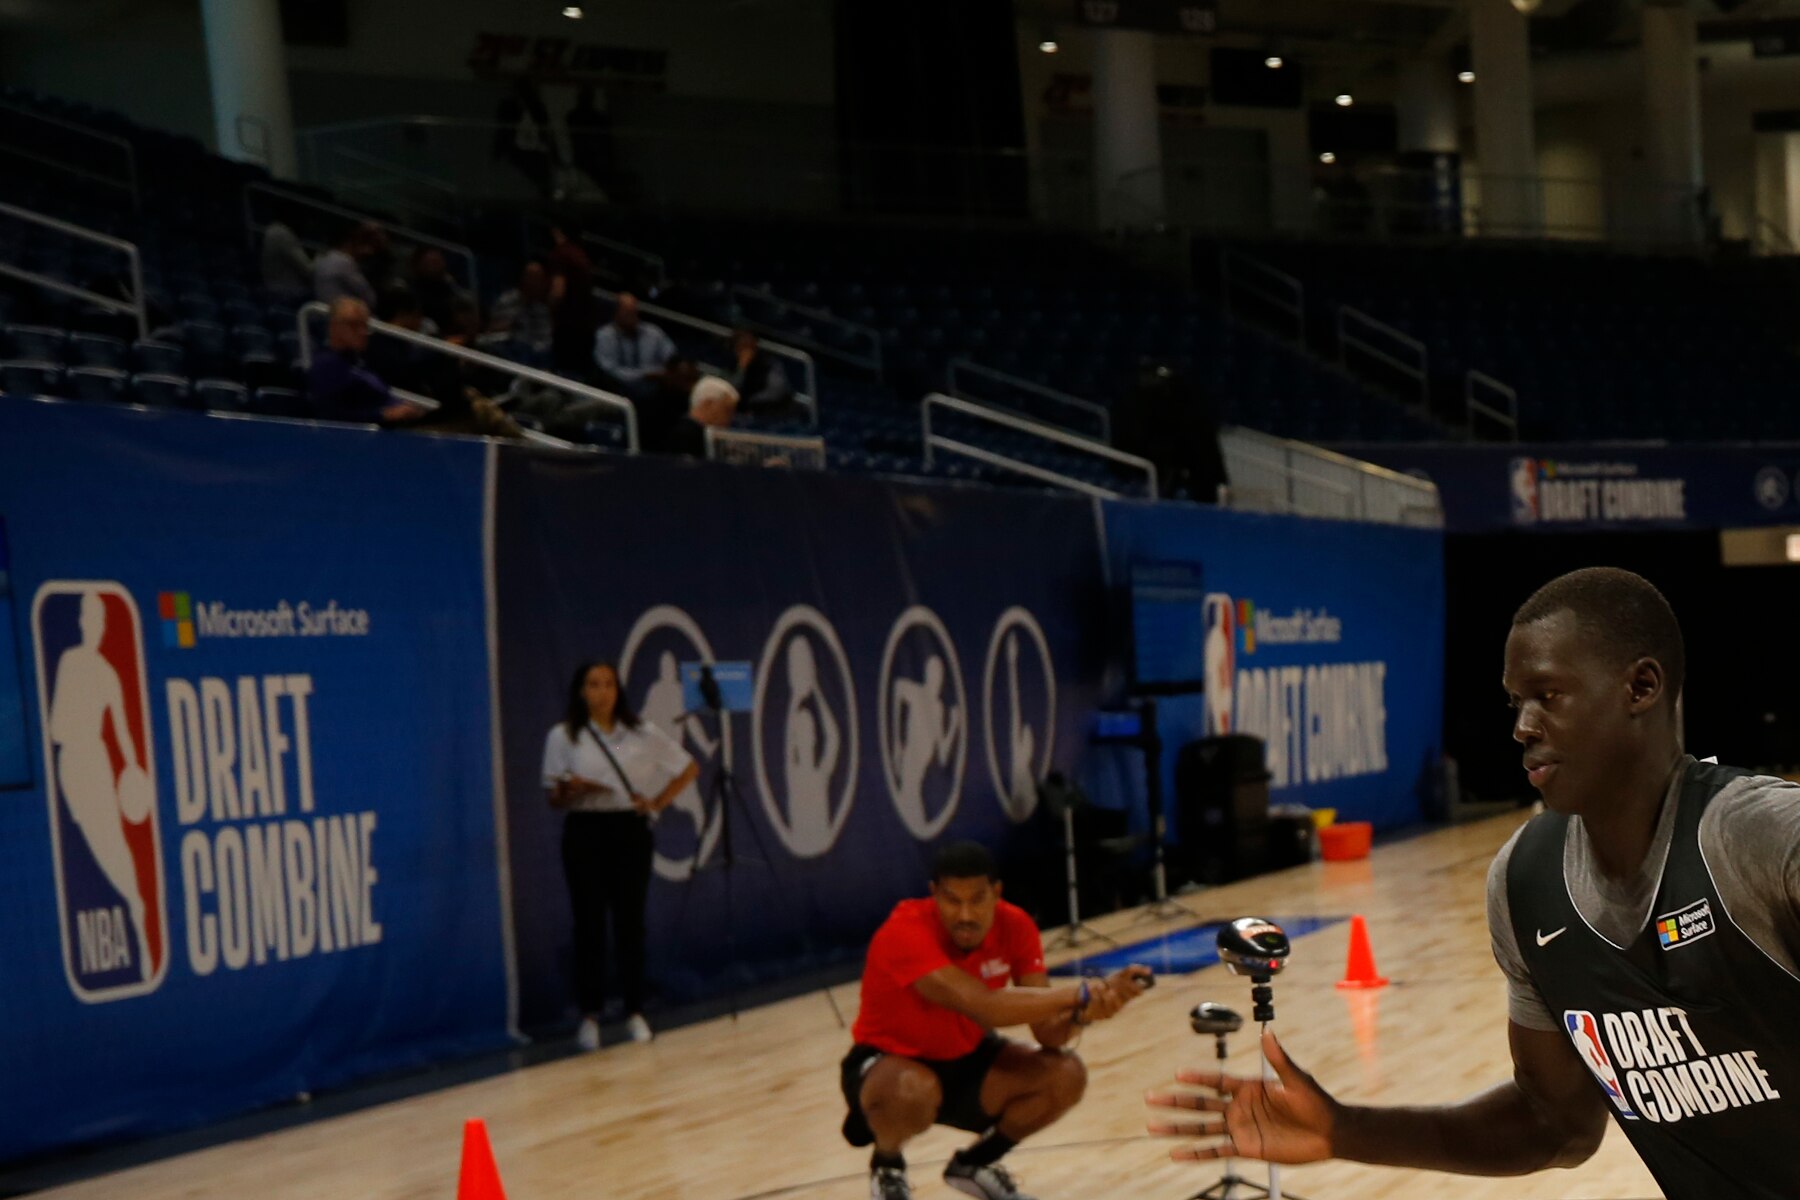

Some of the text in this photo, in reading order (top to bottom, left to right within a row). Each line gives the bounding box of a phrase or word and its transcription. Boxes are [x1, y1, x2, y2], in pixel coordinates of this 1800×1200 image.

[196, 599, 369, 638] Microsoft Surface
[165, 673, 315, 826] DRAFT
[181, 811, 383, 977] COMBINE
[1678, 903, 1711, 927] Microsoft
[77, 904, 131, 975] NBA
[1680, 920, 1709, 939] Surface
[1603, 1006, 1707, 1069] DRAFT
[1626, 1050, 1780, 1123] COMBINE
